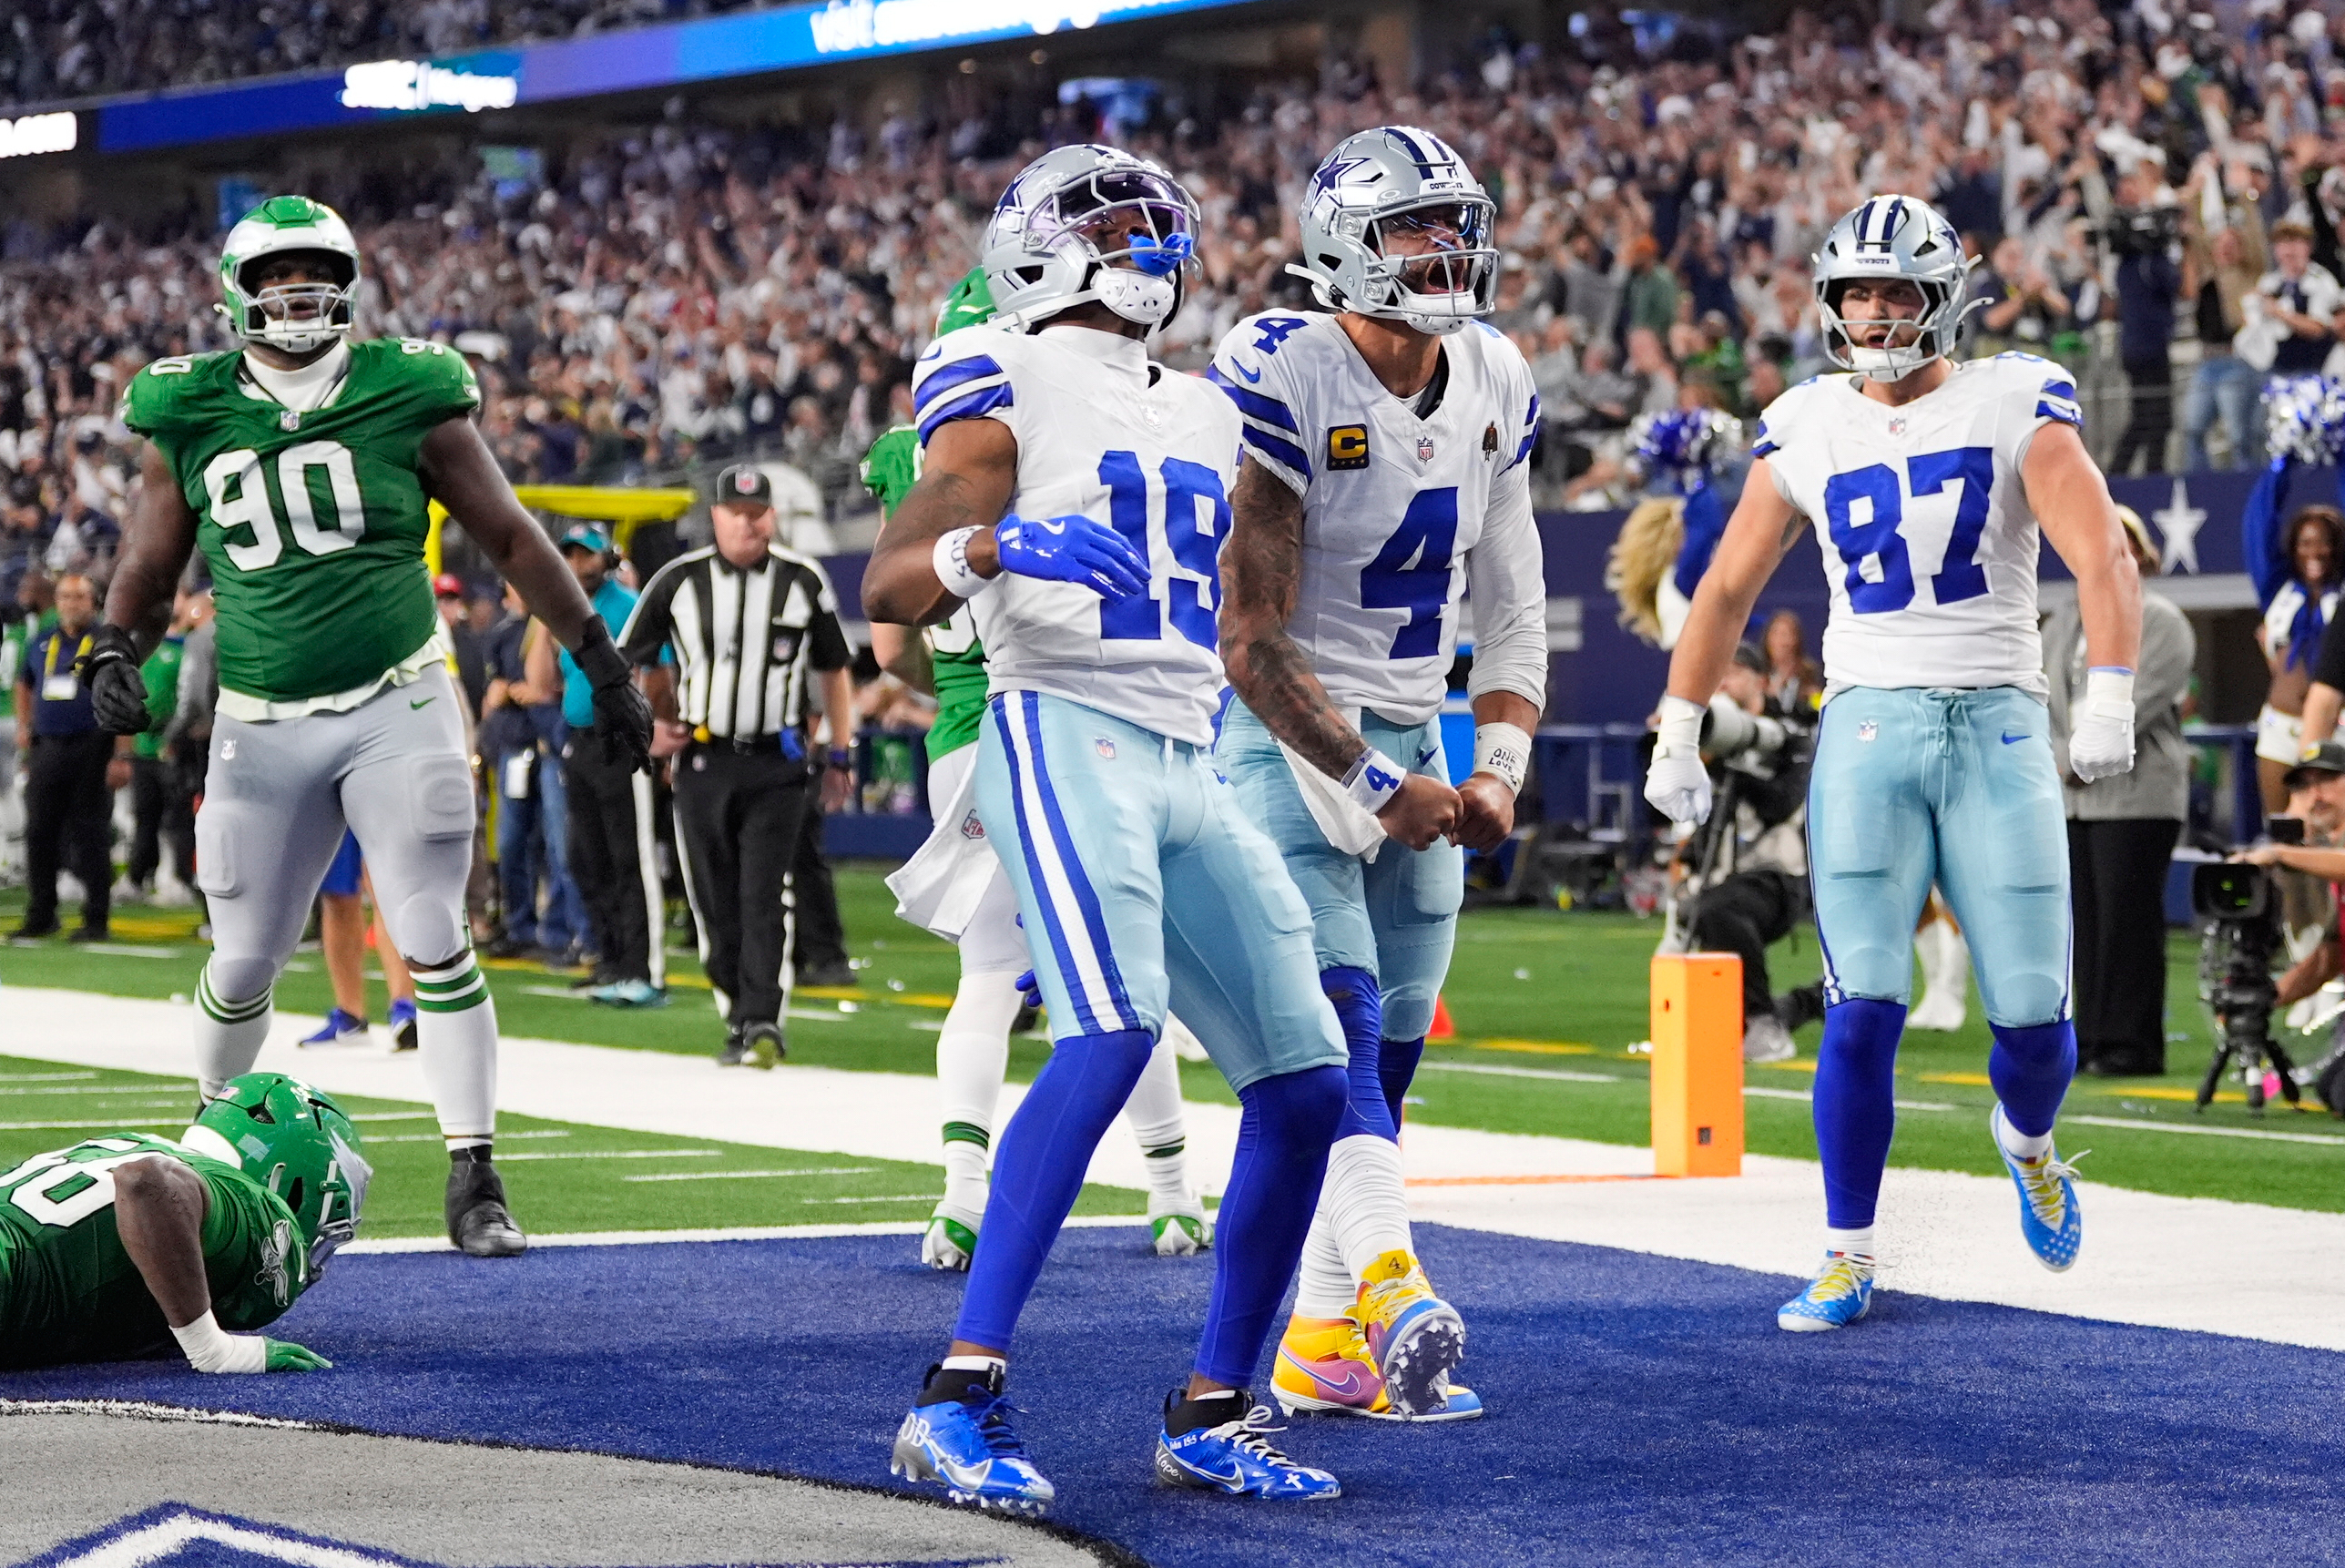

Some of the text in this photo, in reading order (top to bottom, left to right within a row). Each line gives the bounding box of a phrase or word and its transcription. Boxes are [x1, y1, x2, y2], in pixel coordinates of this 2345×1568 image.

[1253, 318, 1309, 355] 4
[1331, 428, 1366, 459] C
[1420, 448, 1432, 458] NFL
[203, 440, 365, 572] 90
[1824, 446, 1994, 615] 87
[1097, 450, 1232, 656] 19
[1361, 486, 1459, 659] 4
[1494, 748, 1517, 764] ONE
[1364, 764, 1400, 792] 4
